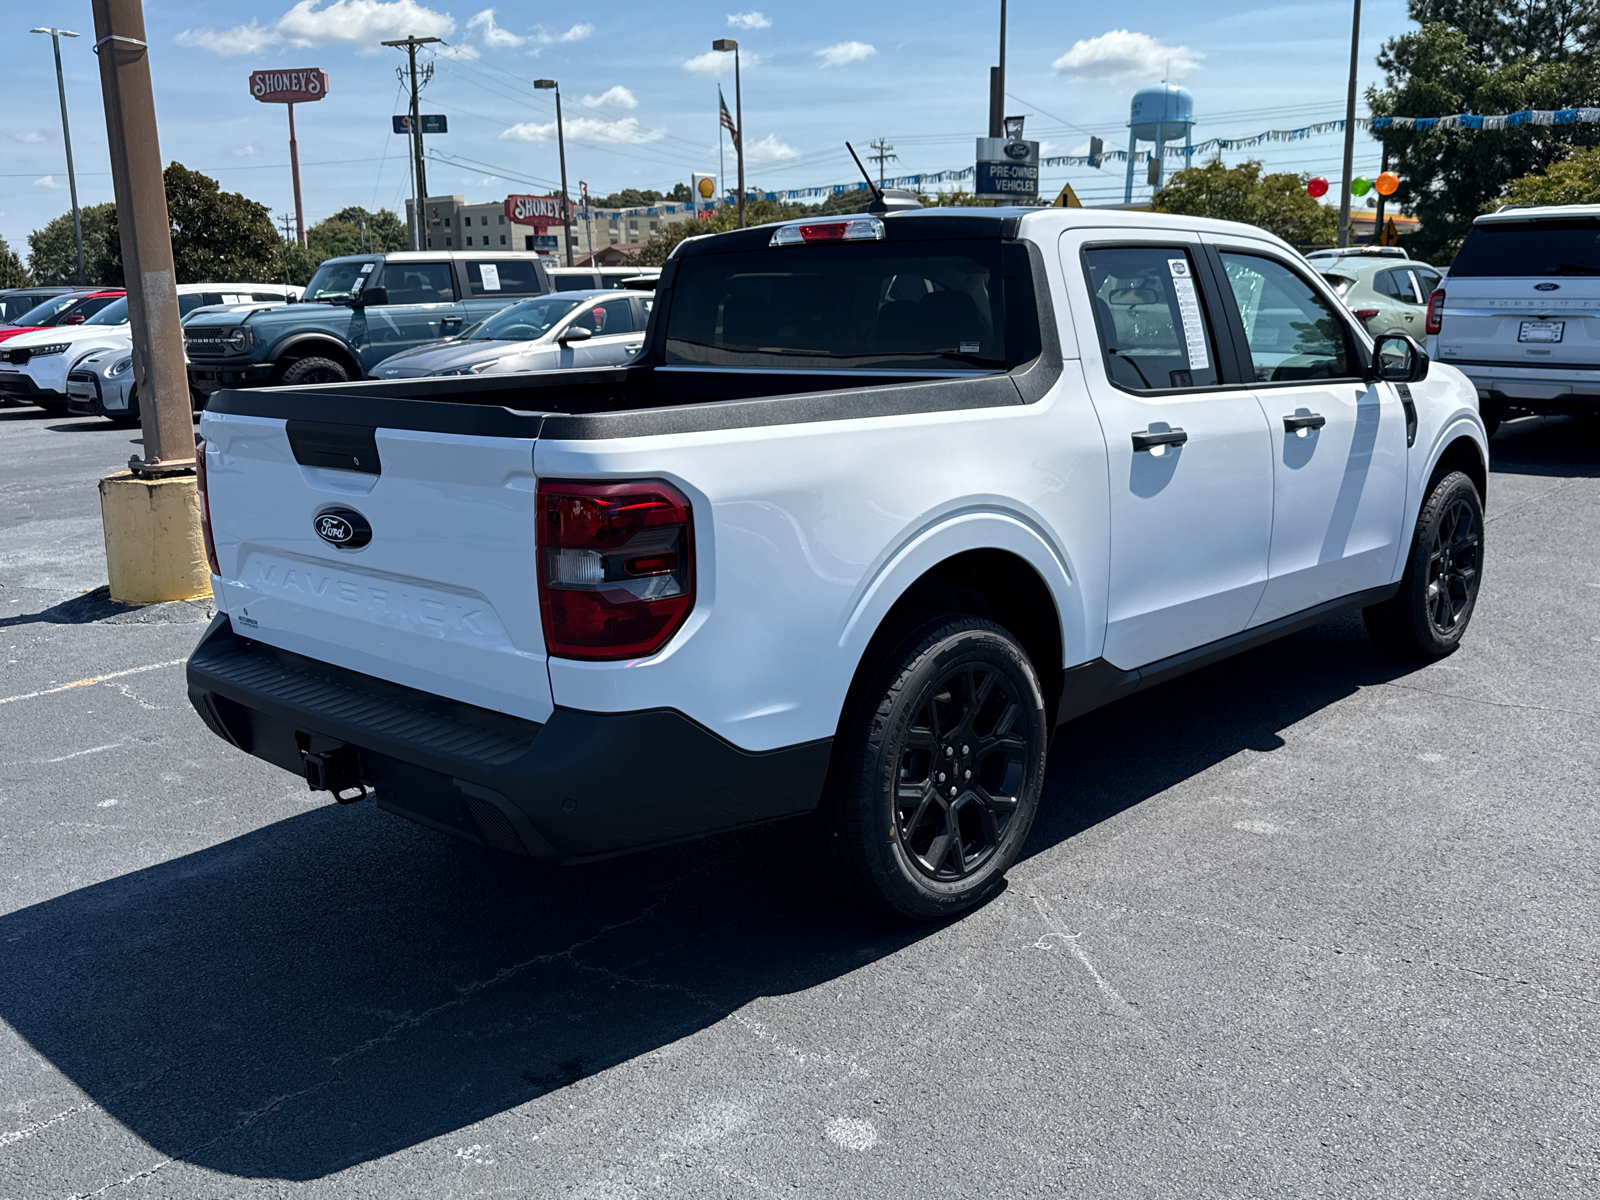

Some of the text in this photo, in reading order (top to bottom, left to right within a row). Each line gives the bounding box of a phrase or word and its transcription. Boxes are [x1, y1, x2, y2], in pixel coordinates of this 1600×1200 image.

[253, 70, 320, 96] SHONEY'S
[990, 165, 1038, 179] PRE-OWNED
[995, 179, 1035, 192] VEHICLES
[514, 198, 565, 220] SHONEY'
[321, 517, 345, 538] Ford
[255, 560, 484, 637] MAVERICK
